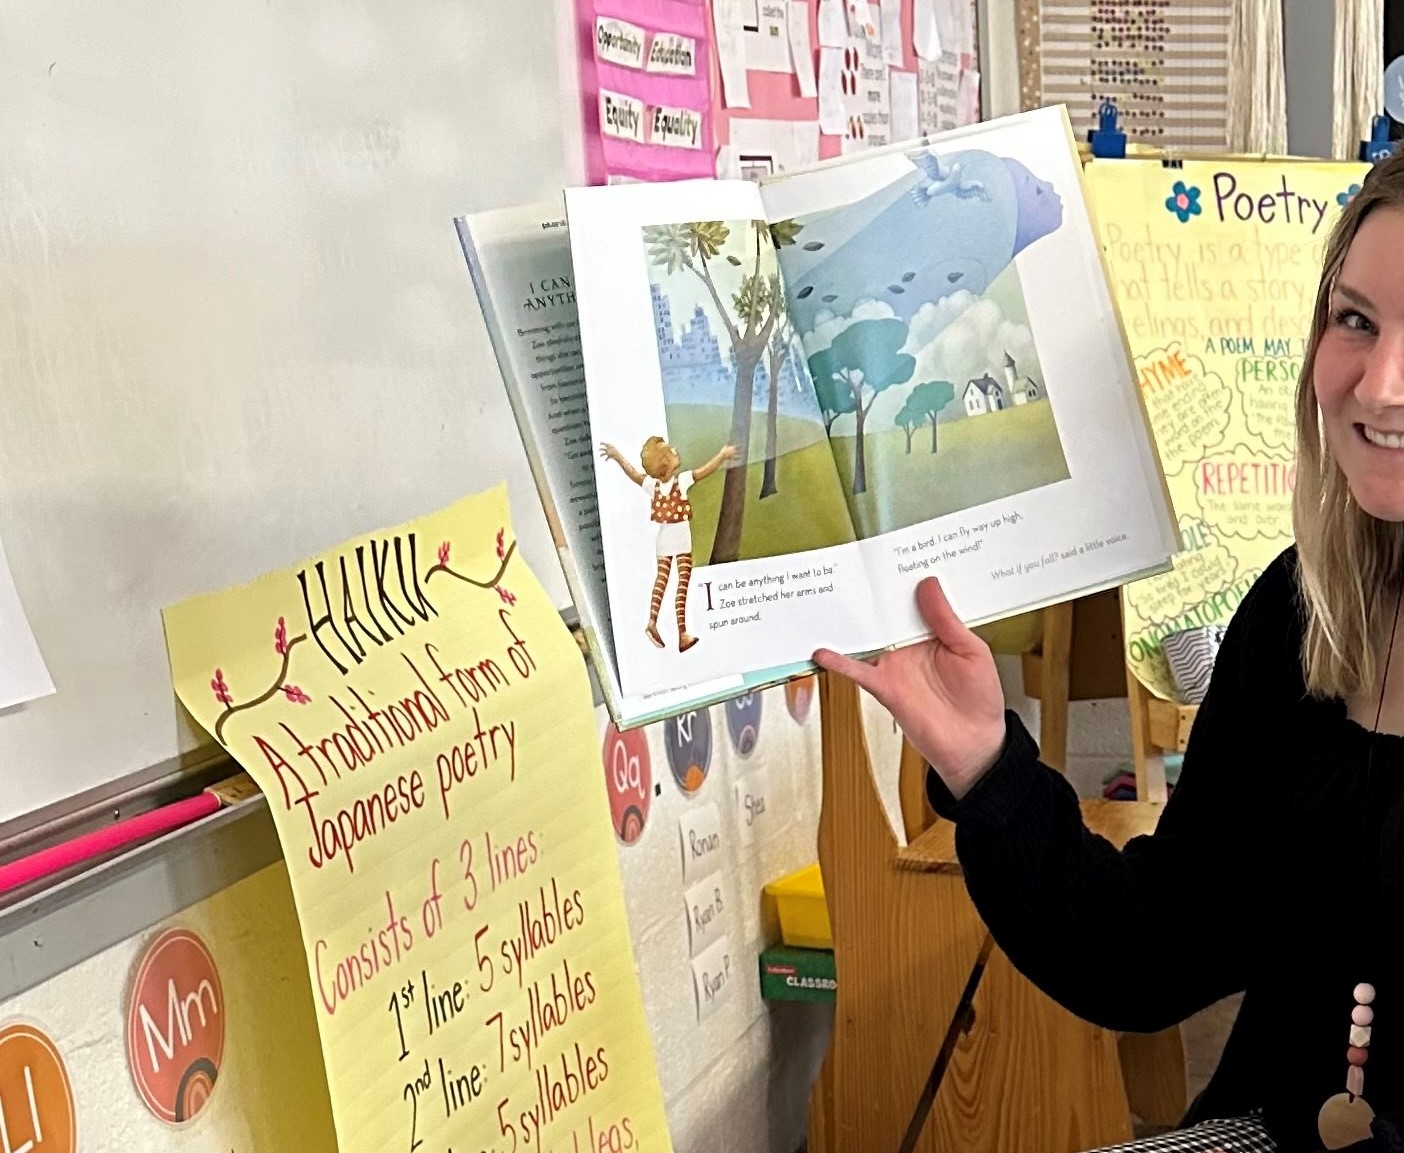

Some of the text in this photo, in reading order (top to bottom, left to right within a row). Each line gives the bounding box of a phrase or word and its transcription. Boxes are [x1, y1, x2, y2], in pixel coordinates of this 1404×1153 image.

[605, 96, 698, 146] Equity Equality
[1212, 171, 1329, 234] Poetry
[1220, 336, 1256, 356] POEM
[1264, 337, 1293, 357] MAY
[930, 555, 942, 564] on
[942, 548, 957, 560] the
[943, 532, 959, 542] can
[972, 523, 988, 533] way
[990, 519, 1002, 528] up
[1182, 522, 1212, 552] OLE
[718, 582, 734, 592] can
[735, 579, 747, 589] be
[748, 574, 785, 588] anything
[792, 569, 811, 580] want
[813, 568, 822, 577] to
[720, 582, 834, 610] Zoe stretched her arms and
[1024, 561, 1040, 573] you
[296, 532, 439, 675] HAIKU
[252, 608, 538, 811] A traditional form of
[295, 706, 517, 874] Japanese poetry
[612, 739, 646, 800] Qq
[315, 890, 414, 1016] Consists
[422, 858, 445, 939] of
[459, 838, 479, 912] 3
[474, 924, 495, 993] 5
[499, 876, 586, 988] syllables
[138, 977, 218, 1074] Mm
[402, 1059, 433, 1153] 2nd
[484, 1010, 506, 1075] 7
[508, 958, 597, 1072] syllables
